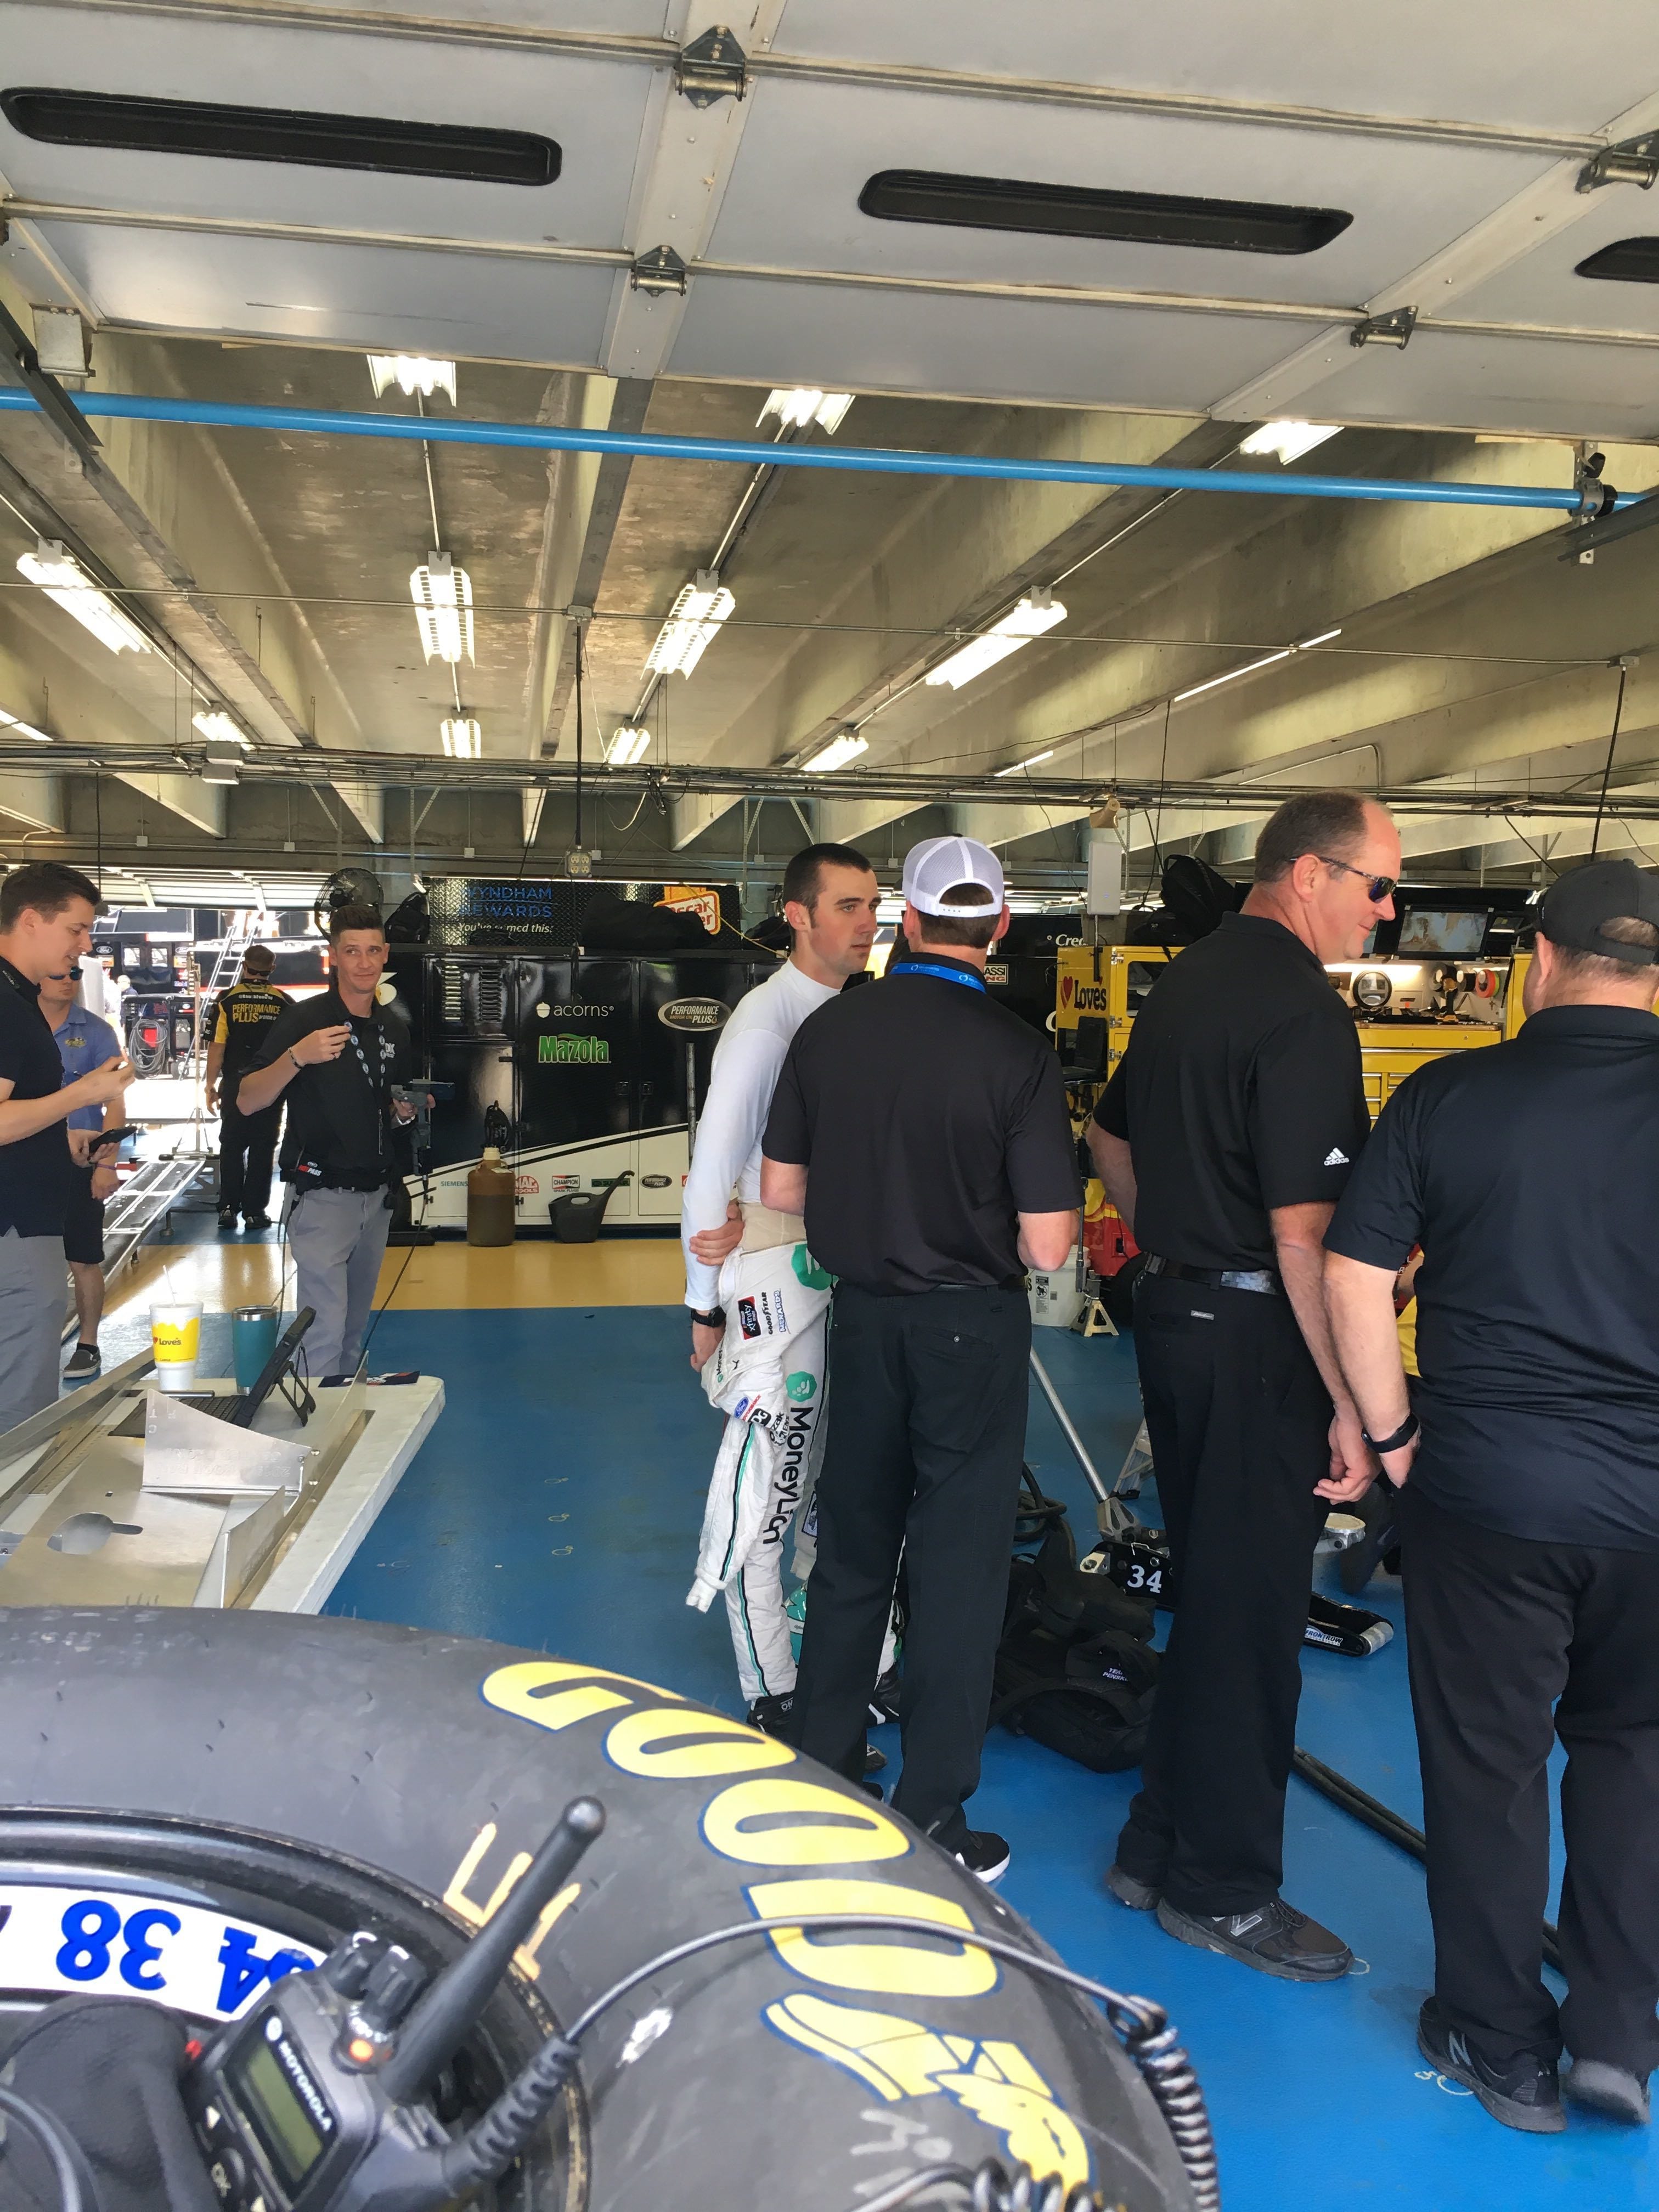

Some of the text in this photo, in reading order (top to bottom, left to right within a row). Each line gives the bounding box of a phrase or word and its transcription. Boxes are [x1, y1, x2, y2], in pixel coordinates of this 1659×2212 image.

[461, 886, 553, 900] WYNDHAM
[459, 905, 553, 918] REWARDS
[233, 1003, 281, 1015] PERFORMANCE
[670, 1006, 720, 1015] PERFORMANCE
[233, 1012, 259, 1023] PLUS
[692, 1015, 712, 1024] PLUS
[538, 1035, 610, 1064] Mazola
[1324, 1157, 1350, 1166] adidas
[761, 1291, 773, 1335] GOODYEAR
[774, 1290, 786, 1333] MENARDS
[1127, 1565, 1163, 1594] 34
[1102, 1672, 1128, 1681] PENSK
[55, 1899, 182, 1991] 38
[278, 2041, 332, 2132] MOTOROLA
